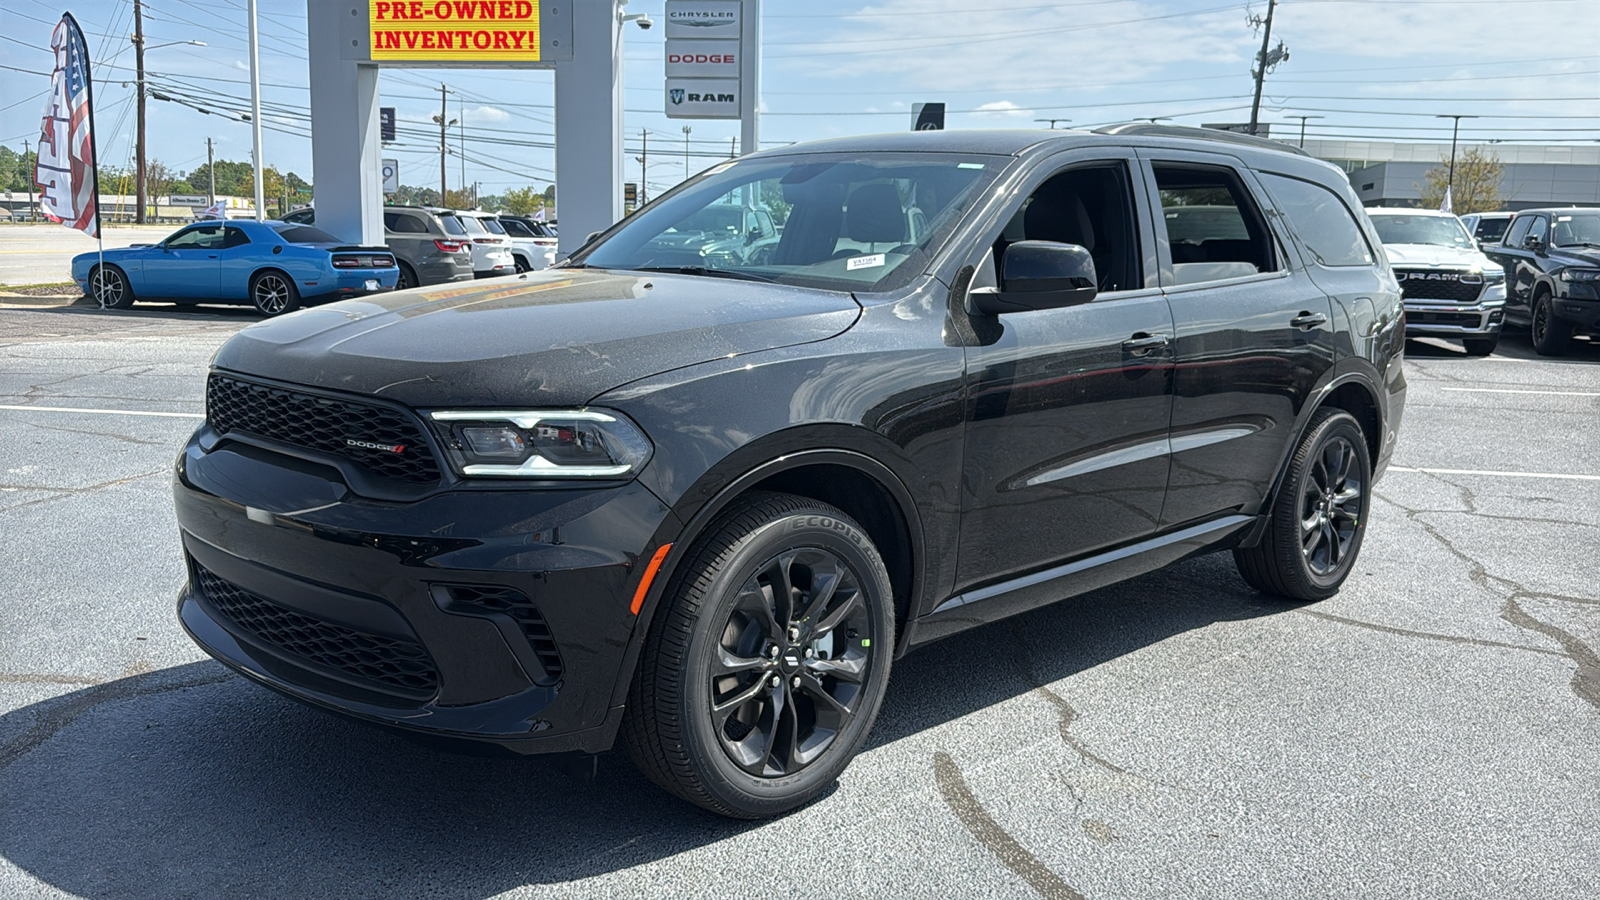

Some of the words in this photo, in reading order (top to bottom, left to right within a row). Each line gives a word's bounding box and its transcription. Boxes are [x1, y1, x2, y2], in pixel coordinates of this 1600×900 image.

[375, 0, 533, 20] PRE-OWNED
[374, 30, 535, 50] INVENTORY!
[669, 54, 735, 63] DODGE
[688, 93, 735, 102] RAM
[1409, 272, 1459, 280] RAM
[346, 439, 396, 452] DODGE
